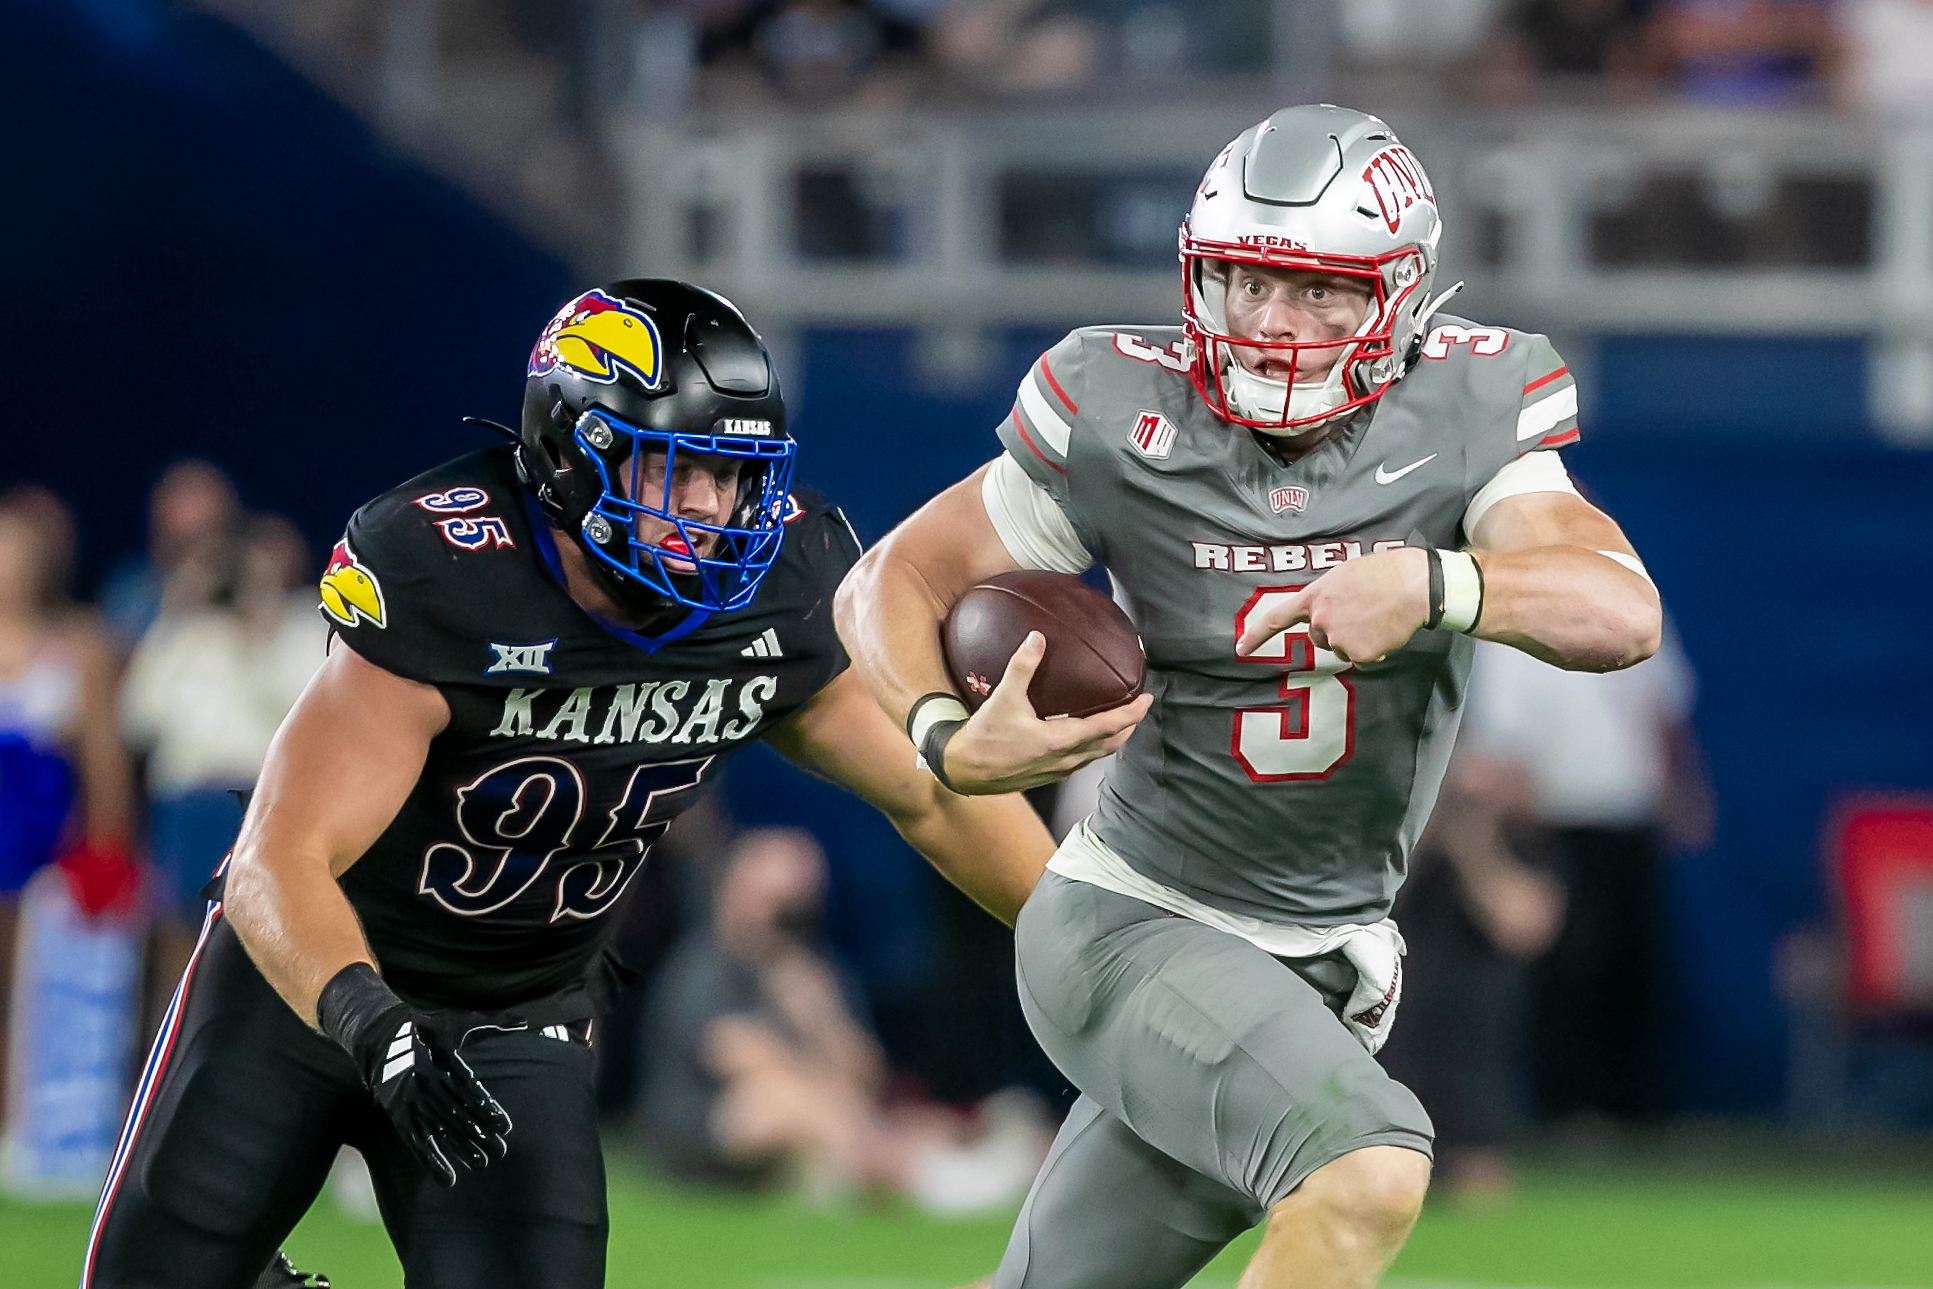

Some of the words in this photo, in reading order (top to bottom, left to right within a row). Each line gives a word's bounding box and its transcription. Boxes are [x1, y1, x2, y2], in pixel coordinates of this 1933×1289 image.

[1361, 147, 1436, 235] UNL
[1236, 235, 1307, 252] VEGAS
[1423, 325, 1510, 360] 3
[722, 418, 772, 437] KANSAS
[411, 486, 516, 553] 95
[1272, 489, 1305, 509] UNLV
[489, 675, 778, 744] KANSAS
[1231, 585, 1355, 782] 3
[418, 754, 716, 924] 95
